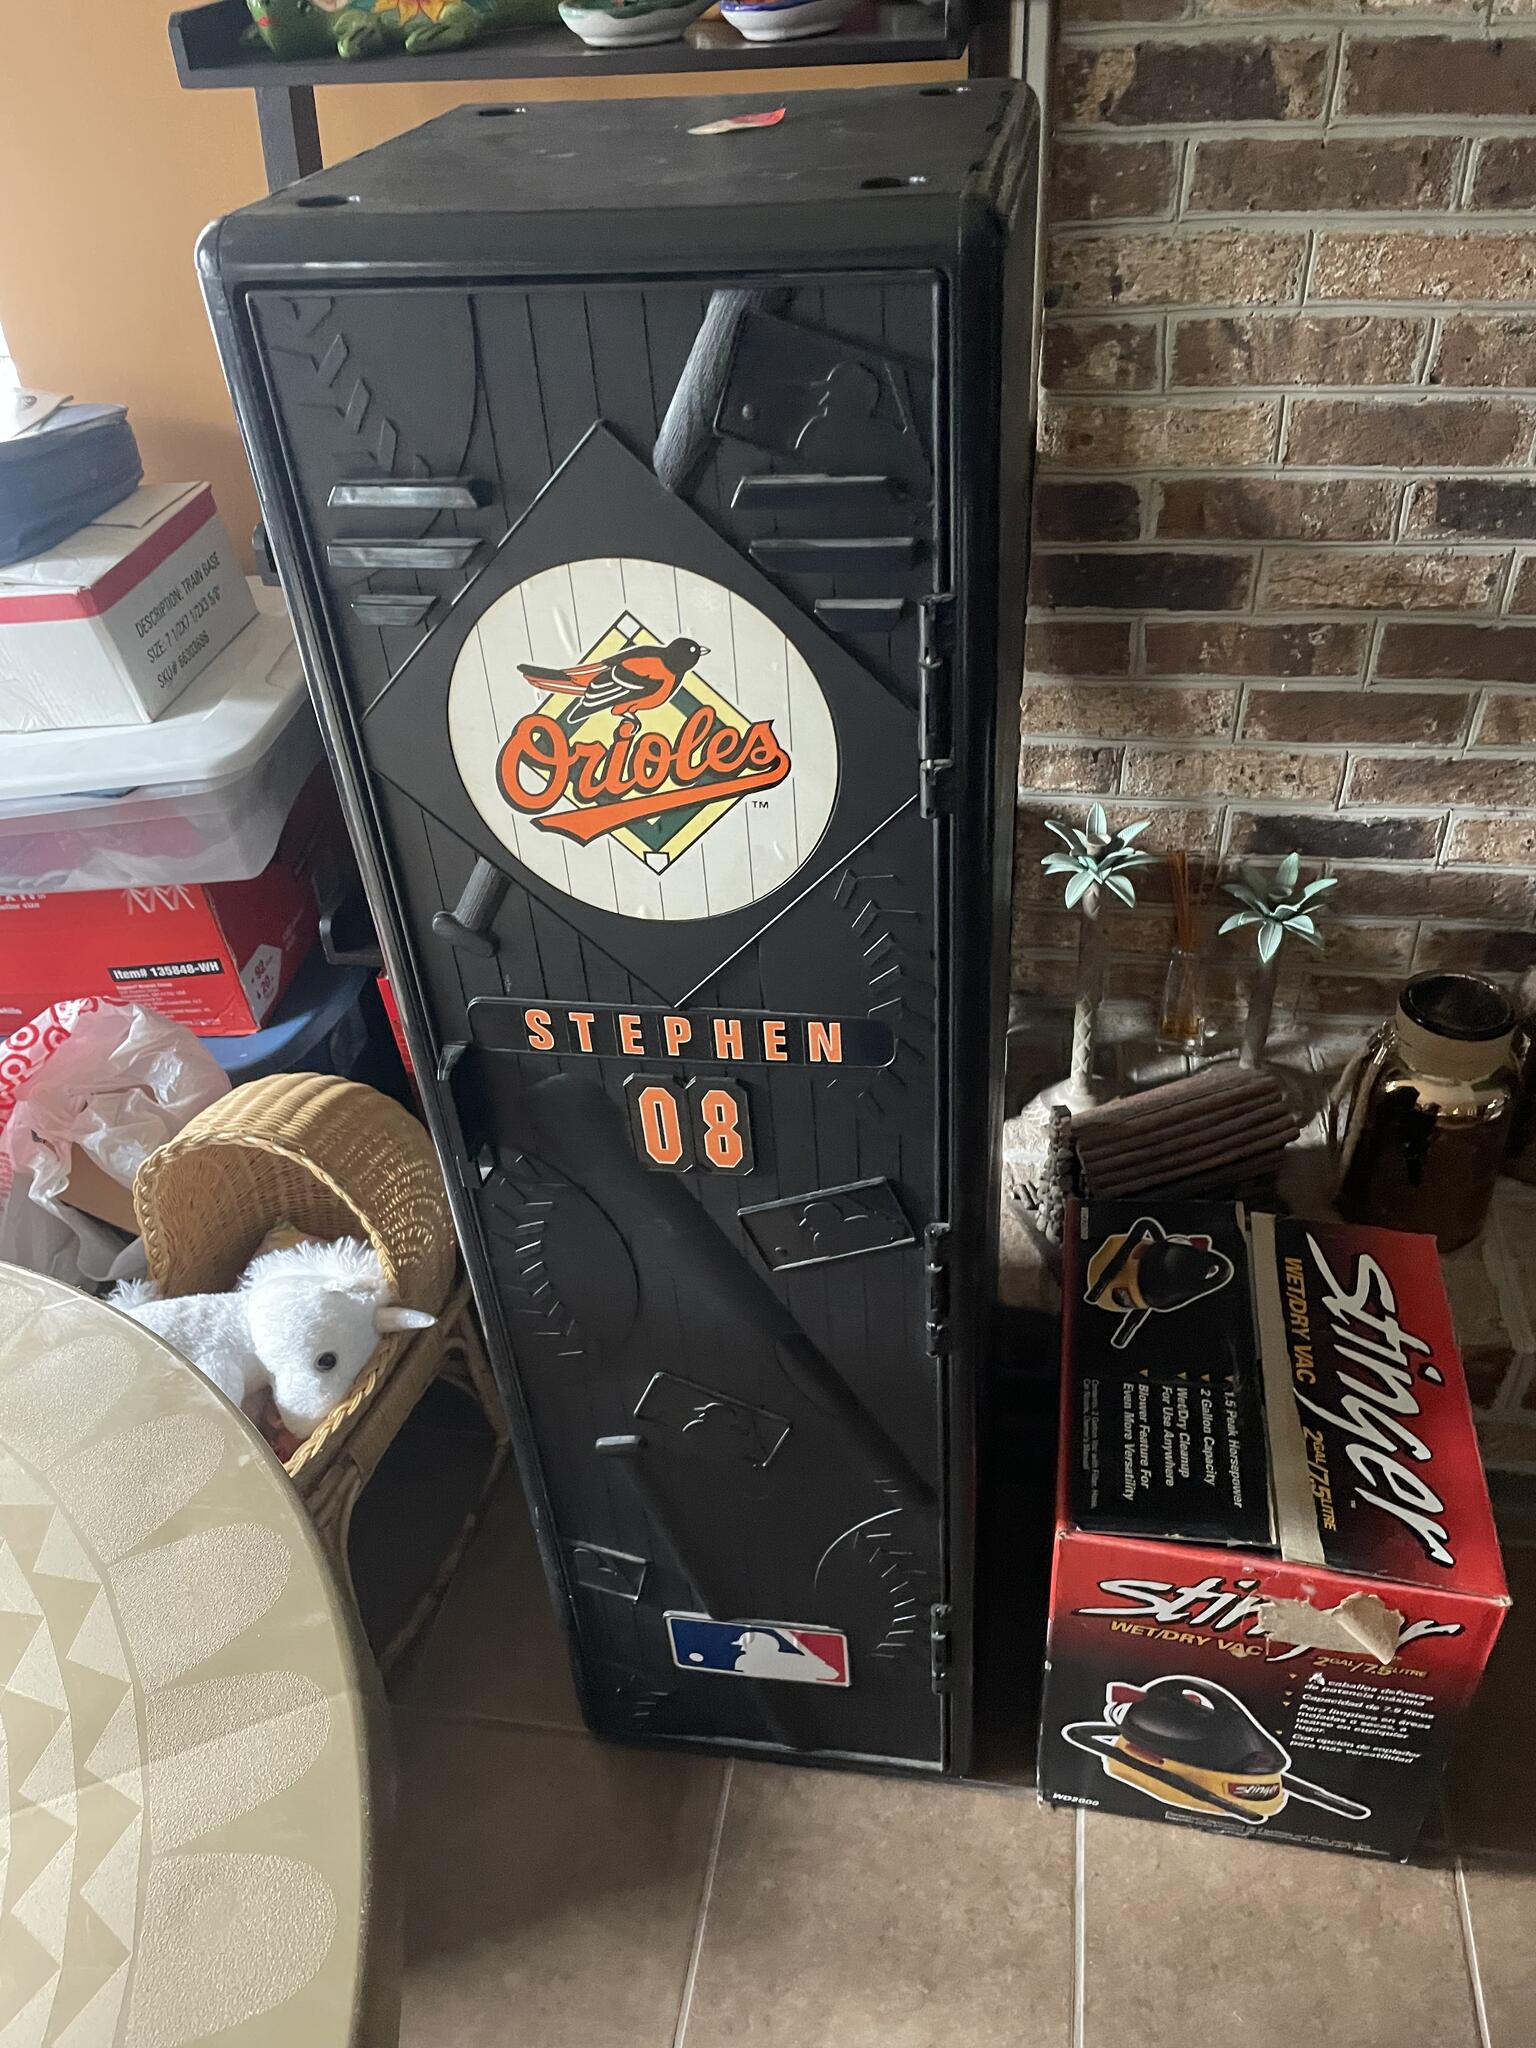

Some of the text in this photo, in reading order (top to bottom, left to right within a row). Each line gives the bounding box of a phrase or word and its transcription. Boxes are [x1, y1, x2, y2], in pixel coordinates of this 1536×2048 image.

[135, 551, 220, 638] DESCRIPTION: TRAIN BASE
[157, 661, 177, 689] SKU#
[496, 704, 791, 818] Orioles
[752, 800, 769, 810] TM
[113, 967, 148, 980] Item#
[524, 1008, 843, 1063] STEPHEN
[638, 1086, 744, 1169] 08
[1285, 1256, 1316, 1384] WET/DRY VAC
[1227, 1409, 1239, 1437] Peak
[1293, 1231, 1455, 1565] Stinger
[1122, 1382, 1136, 1501] Even More Versatility
[1138, 1383, 1152, 1489] Blower Feature For
[1161, 1386, 1176, 1487] For Use Anywhere
[1179, 1432, 1191, 1479] Cleanup
[1200, 1388, 1218, 1487] 2 Gallon Capacity
[1228, 1439, 1243, 1509] Horsepower
[1110, 1620, 1262, 1659] WET/DRY VAC
[1299, 1703, 1326, 1713] Para
[1302, 1693, 1364, 1708] Capacidad
